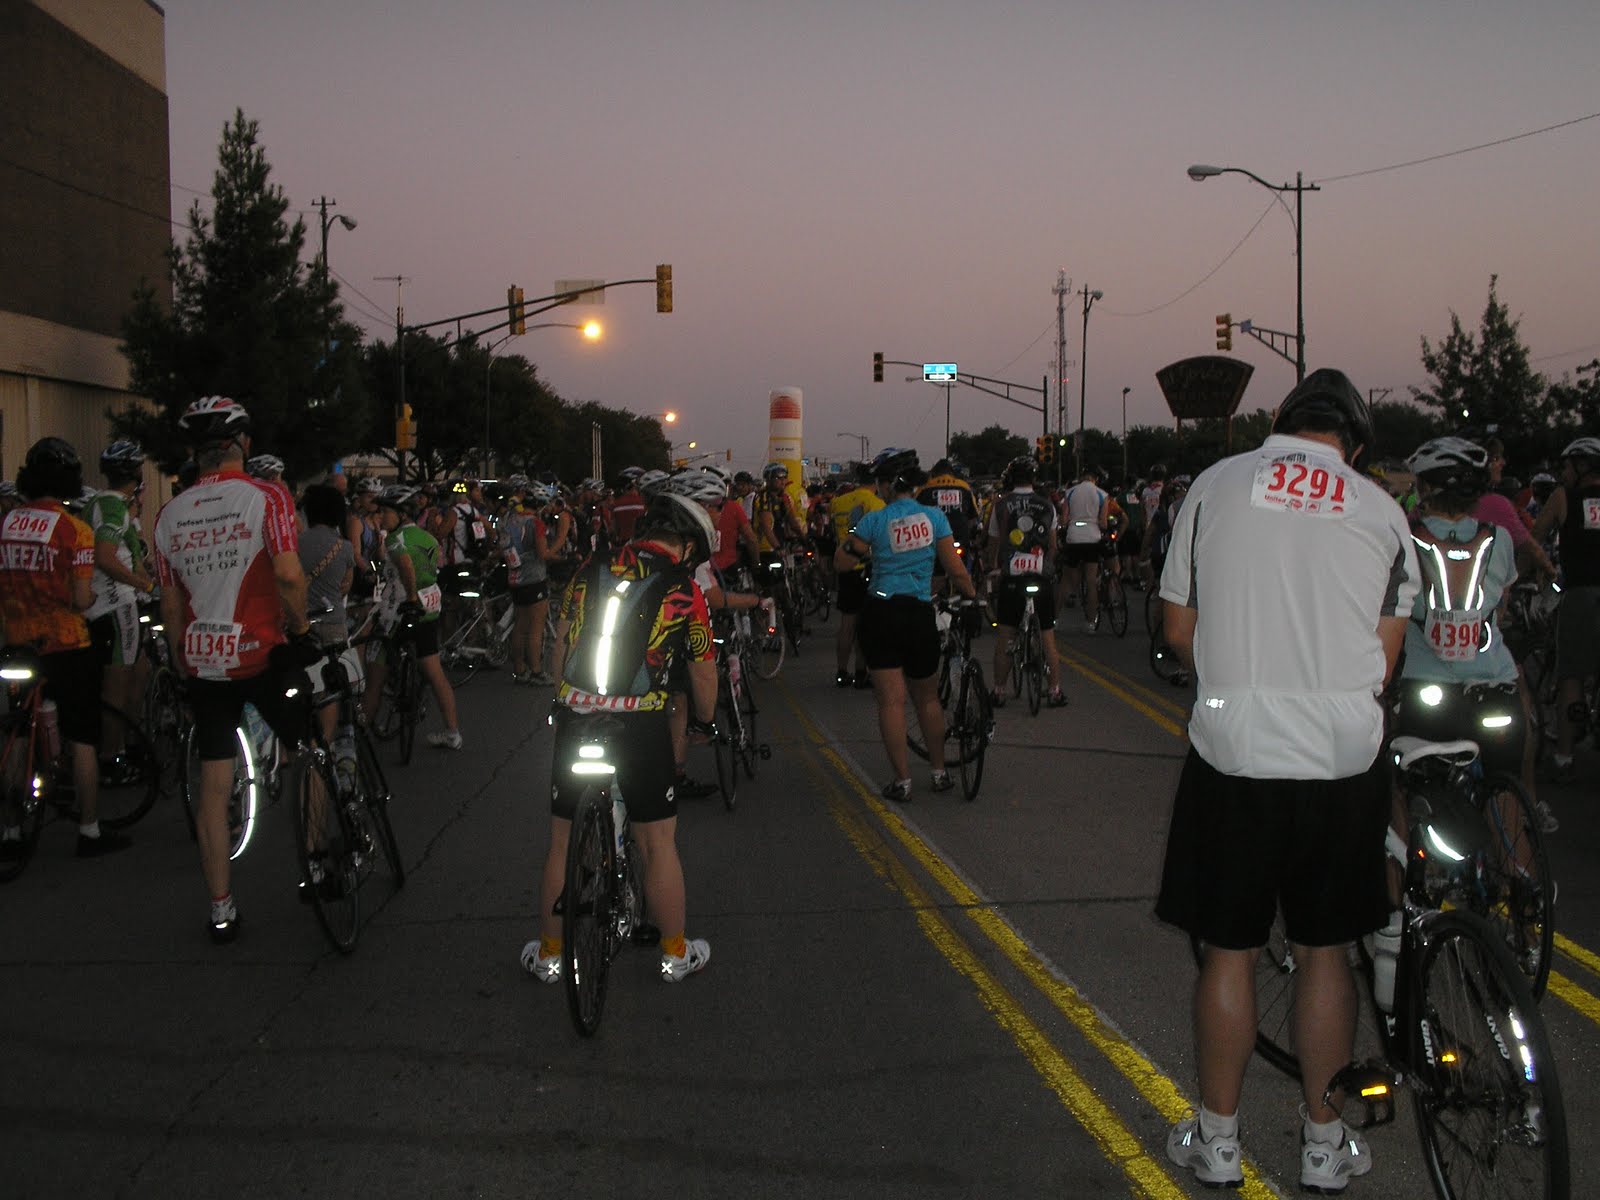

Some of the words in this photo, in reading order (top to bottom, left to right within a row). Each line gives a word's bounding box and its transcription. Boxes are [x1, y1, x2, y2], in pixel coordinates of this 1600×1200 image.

[1267, 463, 1345, 504] 3291
[8, 516, 49, 532] 2046
[893, 521, 930, 545] 7506
[0, 543, 59, 572] HEEZ-IT
[186, 633, 236, 657] 11345
[1431, 622, 1480, 648] 4398
[1420, 1018, 1436, 1067] GIANT
